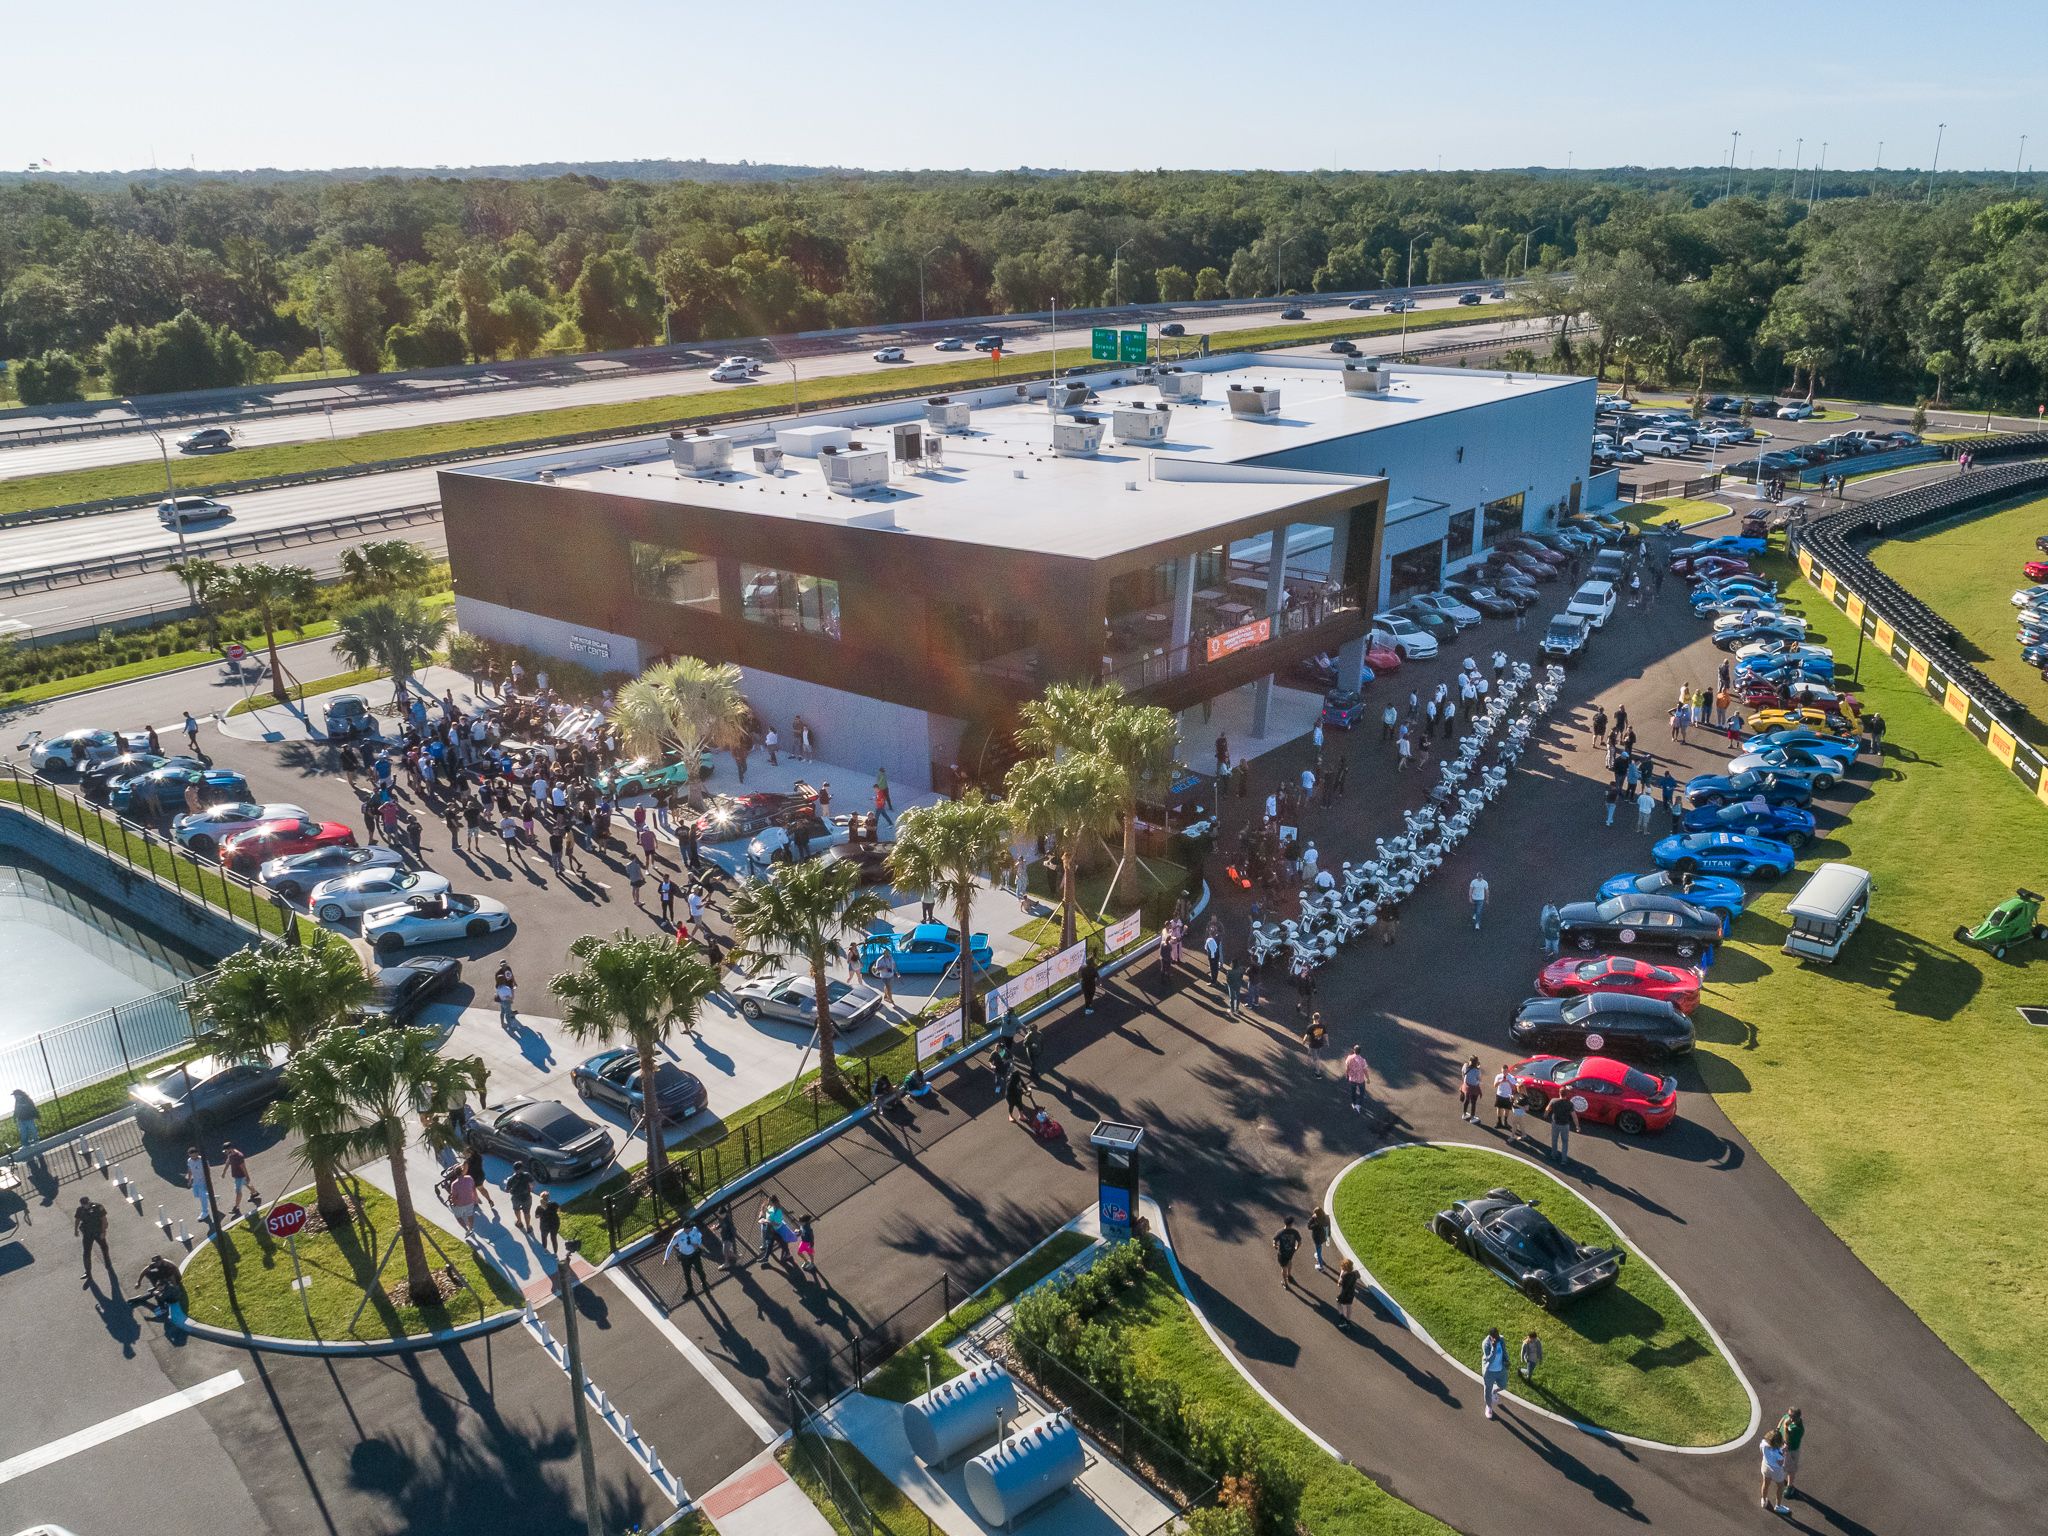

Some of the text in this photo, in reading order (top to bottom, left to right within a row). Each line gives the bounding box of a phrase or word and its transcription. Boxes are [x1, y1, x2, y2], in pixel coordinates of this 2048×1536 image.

[570, 641, 609, 658] EVENT CENTER
[269, 1210, 304, 1231] STOP
